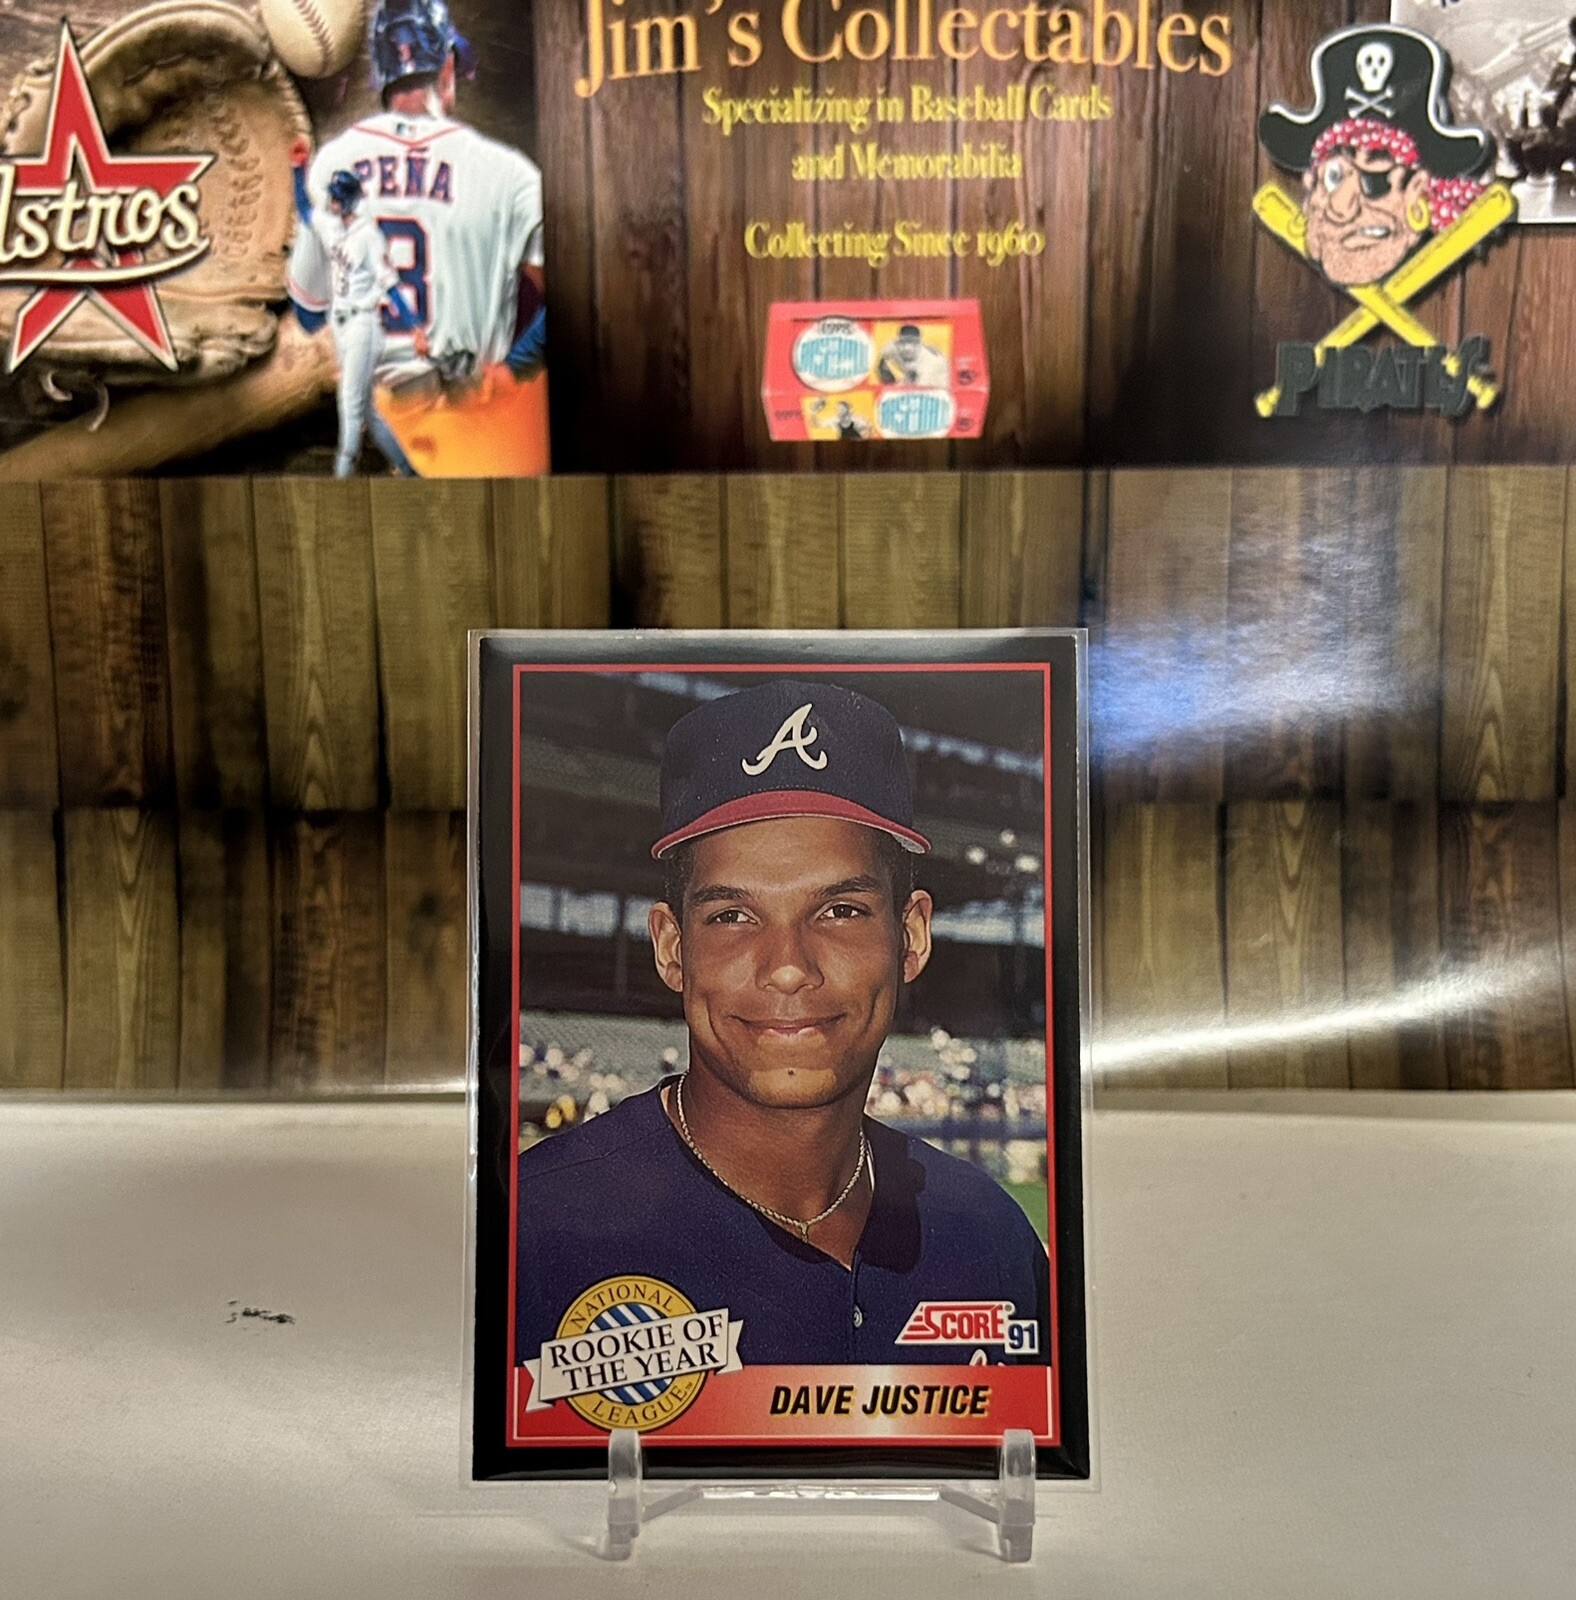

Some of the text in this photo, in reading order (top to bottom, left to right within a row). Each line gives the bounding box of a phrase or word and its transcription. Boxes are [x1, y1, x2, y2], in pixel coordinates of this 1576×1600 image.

[573, 0, 1234, 98] Jim's Collectables
[701, 84, 1113, 136] Specializing in Baseball Cards
[791, 142, 1024, 181] and Memorabilia
[744, 220, 1047, 268] Collecting Since 1960
[1274, 336, 1491, 416] PIRATES
[741, 703, 829, 776] A
[569, 1283, 675, 1330] NATIONAL
[906, 1303, 1036, 1350] SCORE 91
[549, 1313, 724, 1369] ROOKIE OF
[562, 1342, 720, 1392] THE YEAR
[591, 1385, 688, 1425] LEAGUE
[769, 1384, 993, 1417] DAVE JUSTICE
